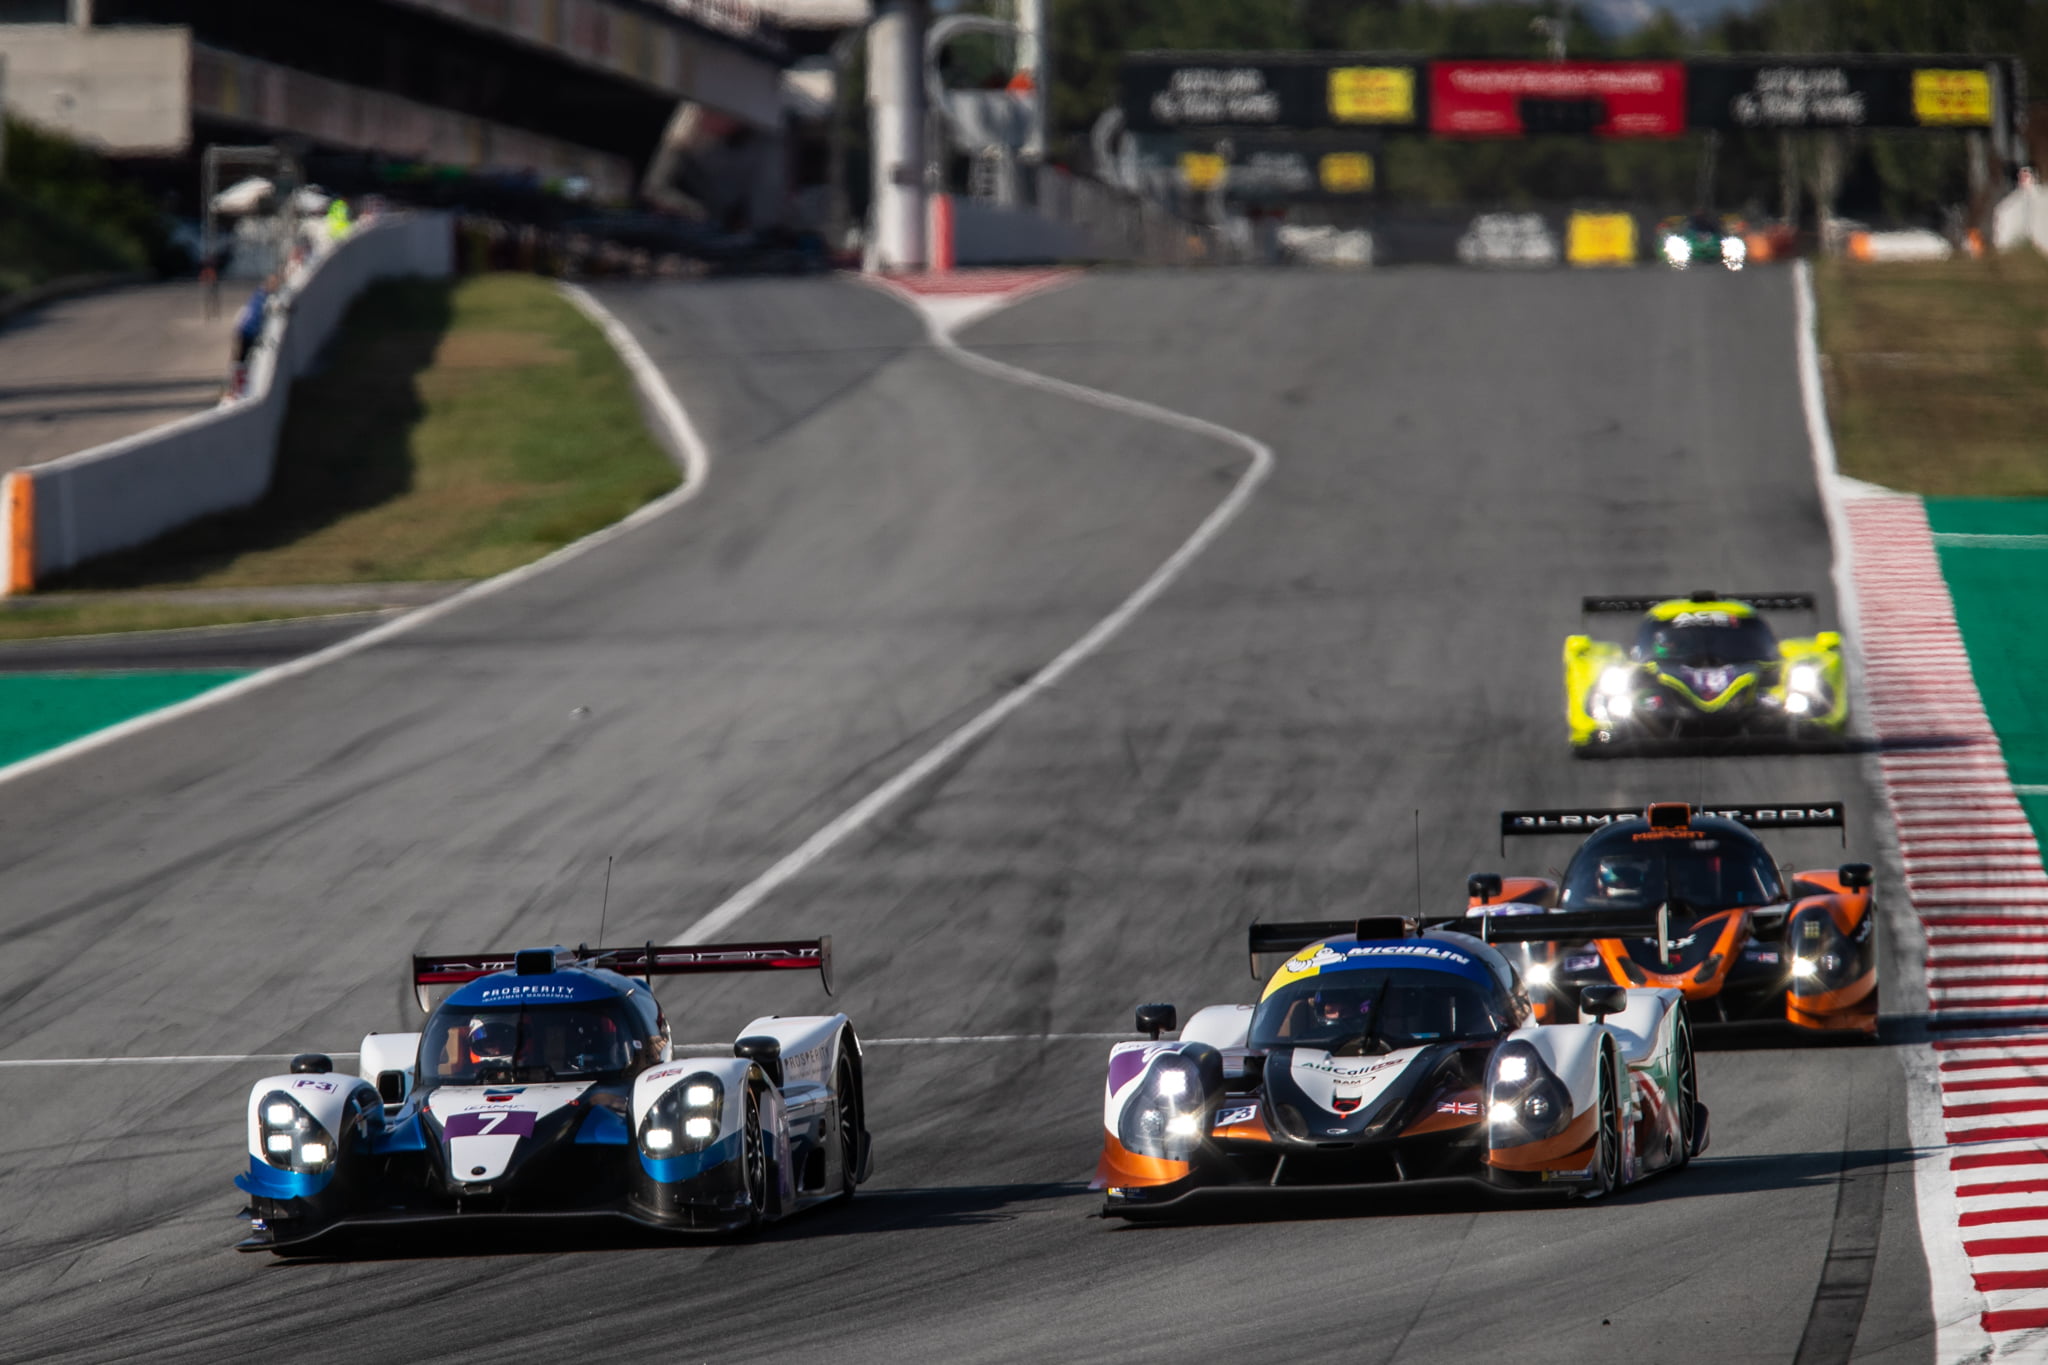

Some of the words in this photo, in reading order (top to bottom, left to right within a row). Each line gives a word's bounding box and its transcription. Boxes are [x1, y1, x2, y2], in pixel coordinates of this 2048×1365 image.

[1347, 945, 1470, 965] MICHELIN
[482, 985, 575, 998] PROSPERITY
[783, 1046, 829, 1070] PROSPERITY
[296, 1080, 333, 1091] P3
[477, 1111, 509, 1135] 7
[1217, 1107, 1252, 1124] P3
